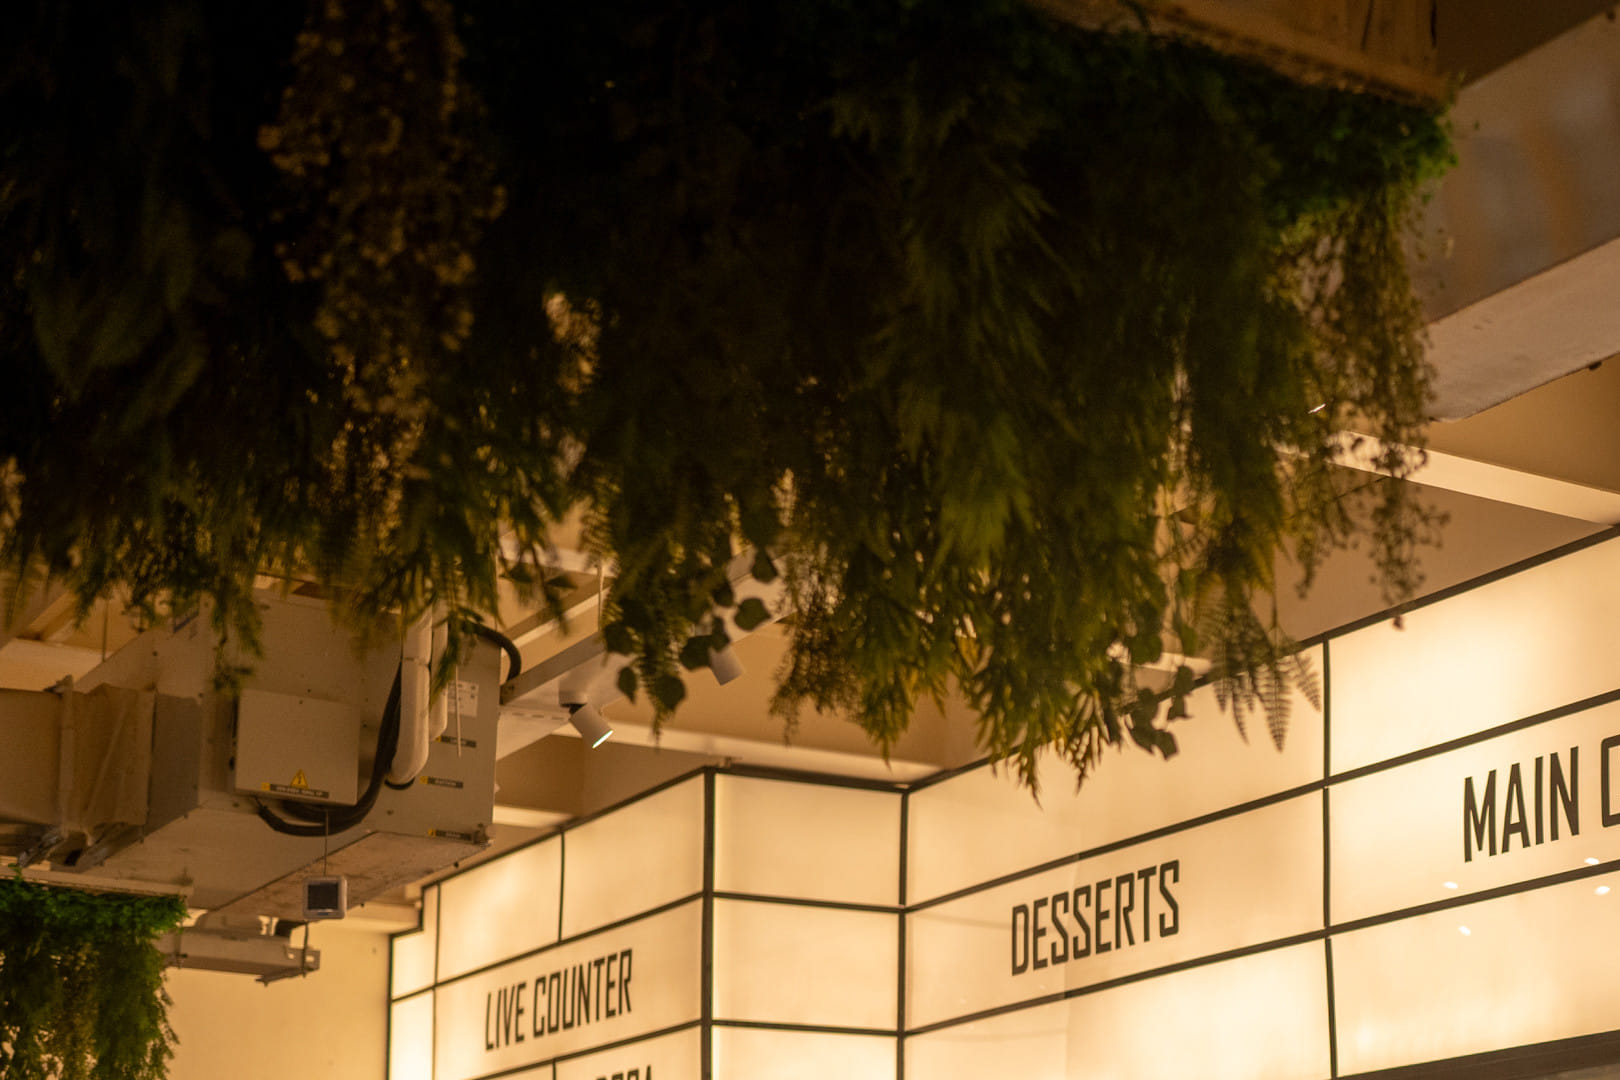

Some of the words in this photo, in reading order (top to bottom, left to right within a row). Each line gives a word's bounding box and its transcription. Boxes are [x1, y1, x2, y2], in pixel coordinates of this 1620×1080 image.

[1463, 745, 1580, 863] MAIN
[1011, 859, 1180, 977] DESSERTS
[485, 982, 526, 1051] LIVE
[533, 948, 632, 1038] COUNTER
